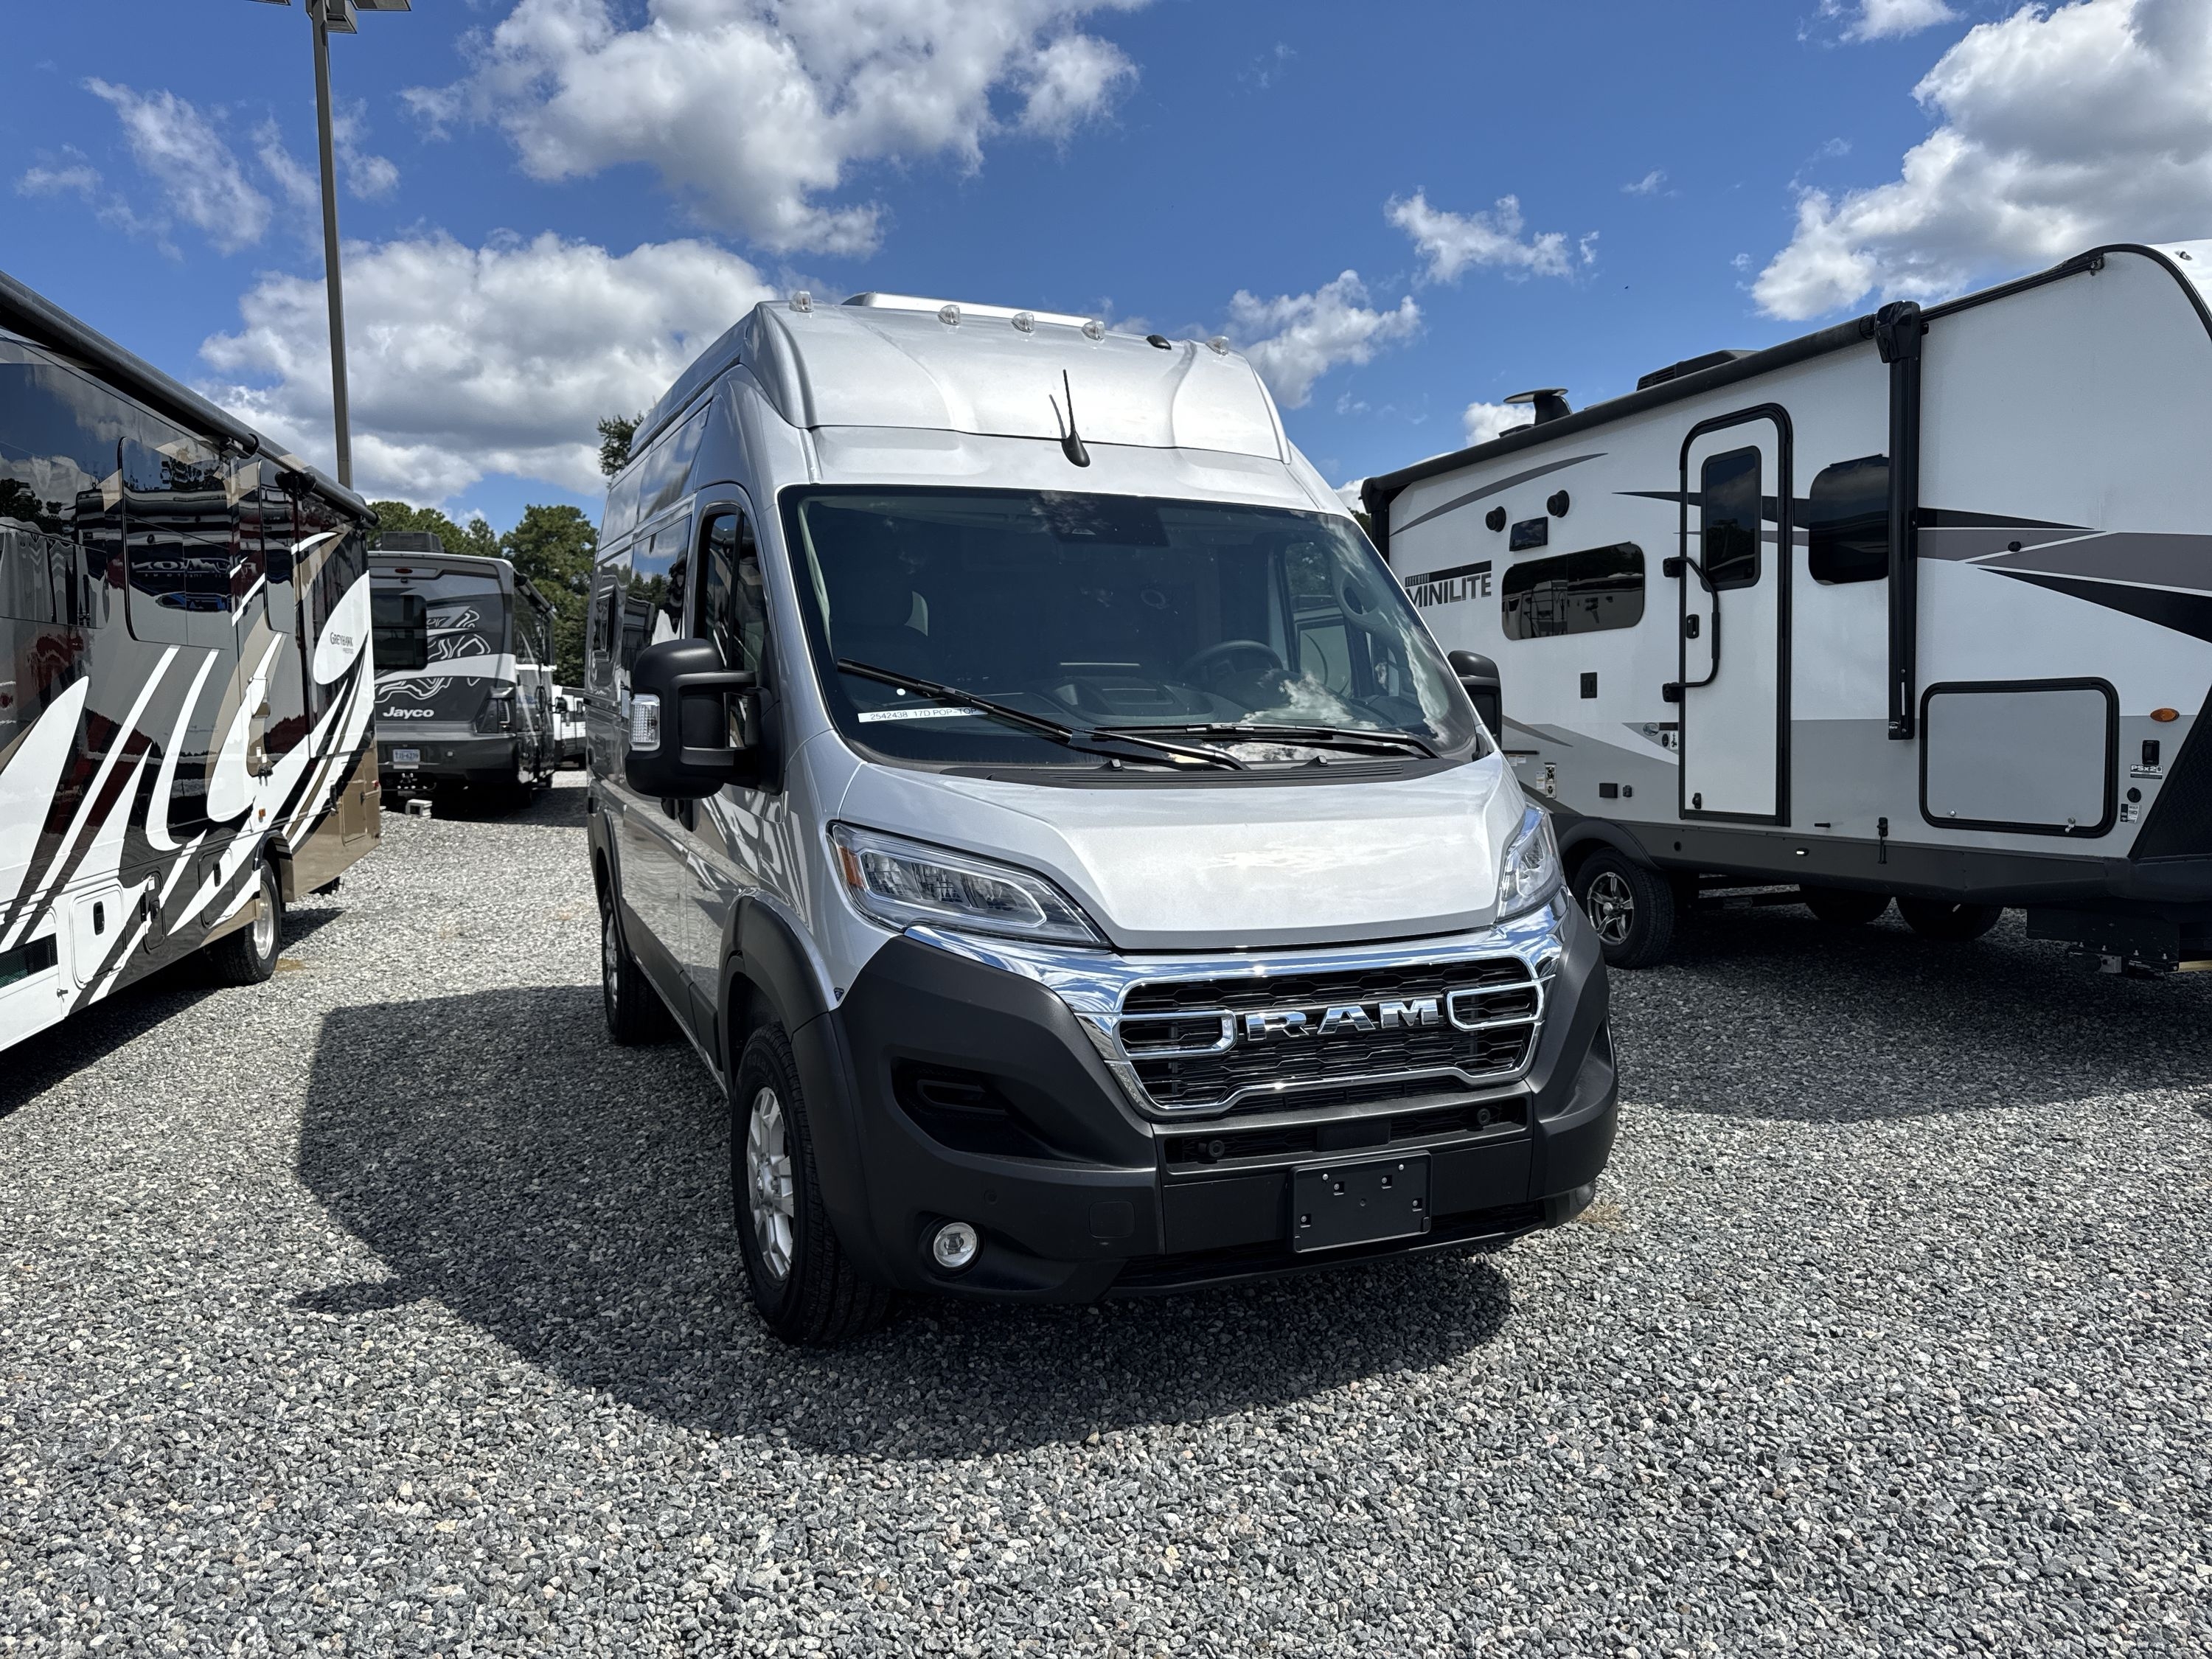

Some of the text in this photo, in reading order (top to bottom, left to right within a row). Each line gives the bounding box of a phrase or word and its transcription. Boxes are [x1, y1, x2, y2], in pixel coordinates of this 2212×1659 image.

[1405, 572, 1492, 608] MINILITE
[382, 706, 435, 720] Jayco
[870, 712, 908, 720] 2542438
[914, 709, 931, 717] 17D
[1245, 998, 1439, 1042] RAM
